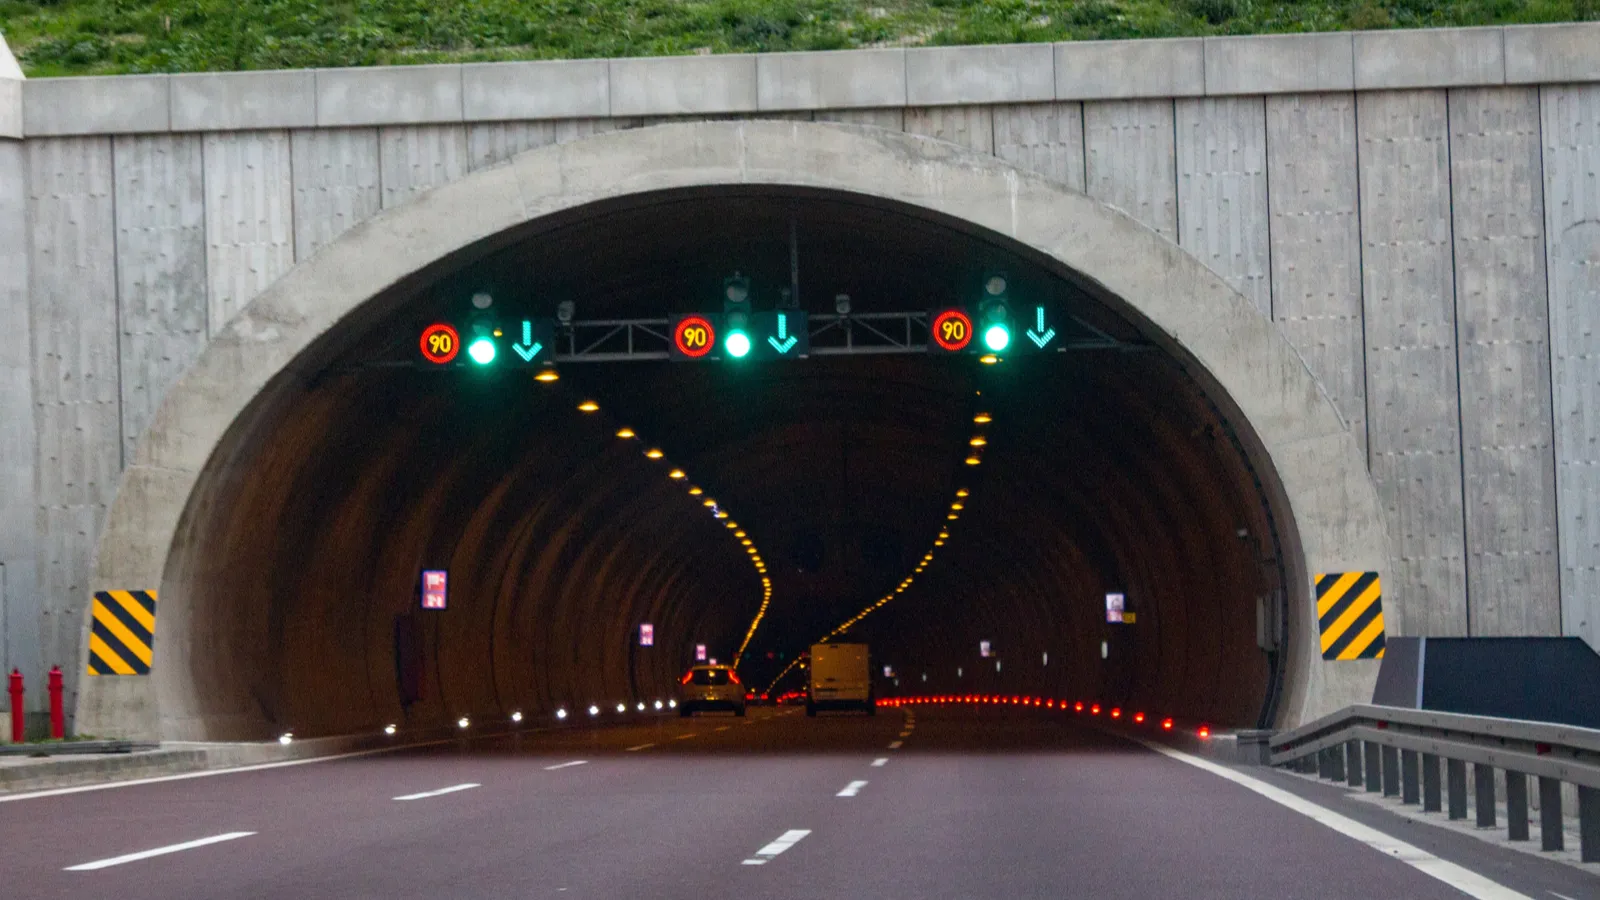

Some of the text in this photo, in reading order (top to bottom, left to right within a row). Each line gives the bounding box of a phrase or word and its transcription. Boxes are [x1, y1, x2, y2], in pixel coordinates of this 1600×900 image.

[684, 328, 706, 347] 90
[942, 321, 964, 340] 90
[429, 335, 451, 353] 90
